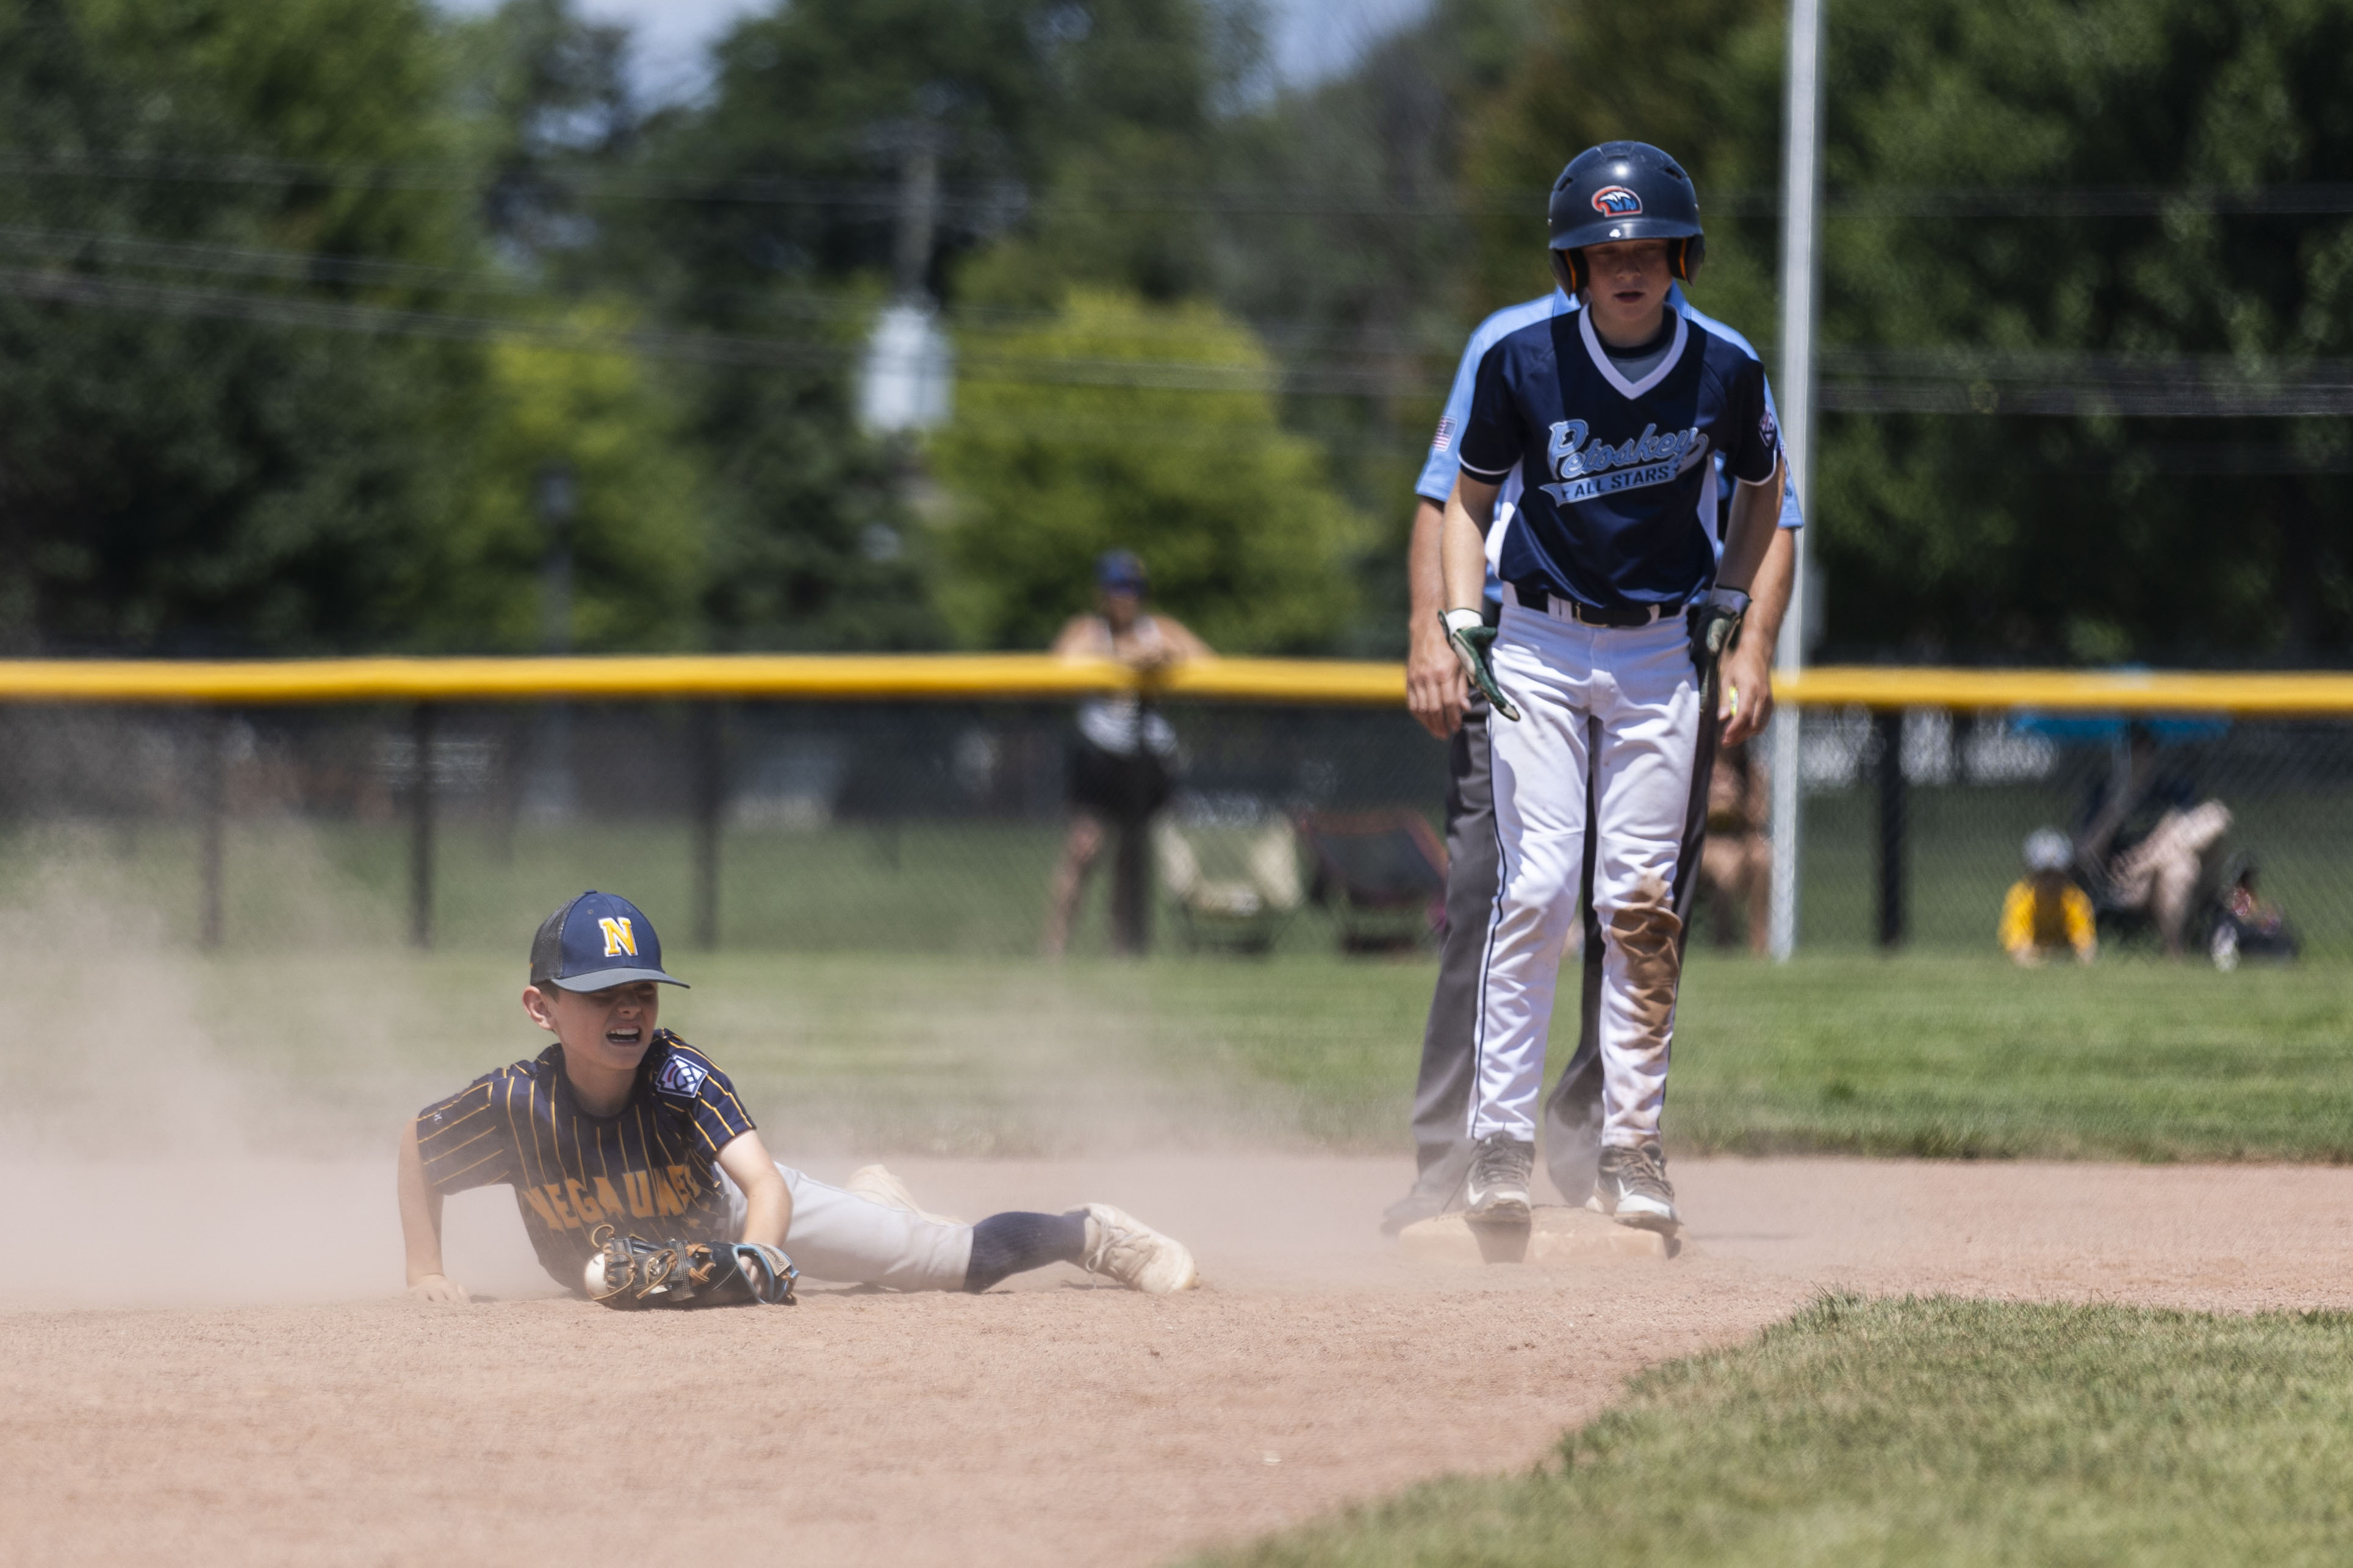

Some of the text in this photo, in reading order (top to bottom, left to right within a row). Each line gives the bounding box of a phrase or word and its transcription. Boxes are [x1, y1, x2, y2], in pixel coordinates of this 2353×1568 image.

[1548, 419, 1707, 480] Petoskey
[1575, 465, 1670, 497] ALL STARS
[598, 917, 638, 957] N
